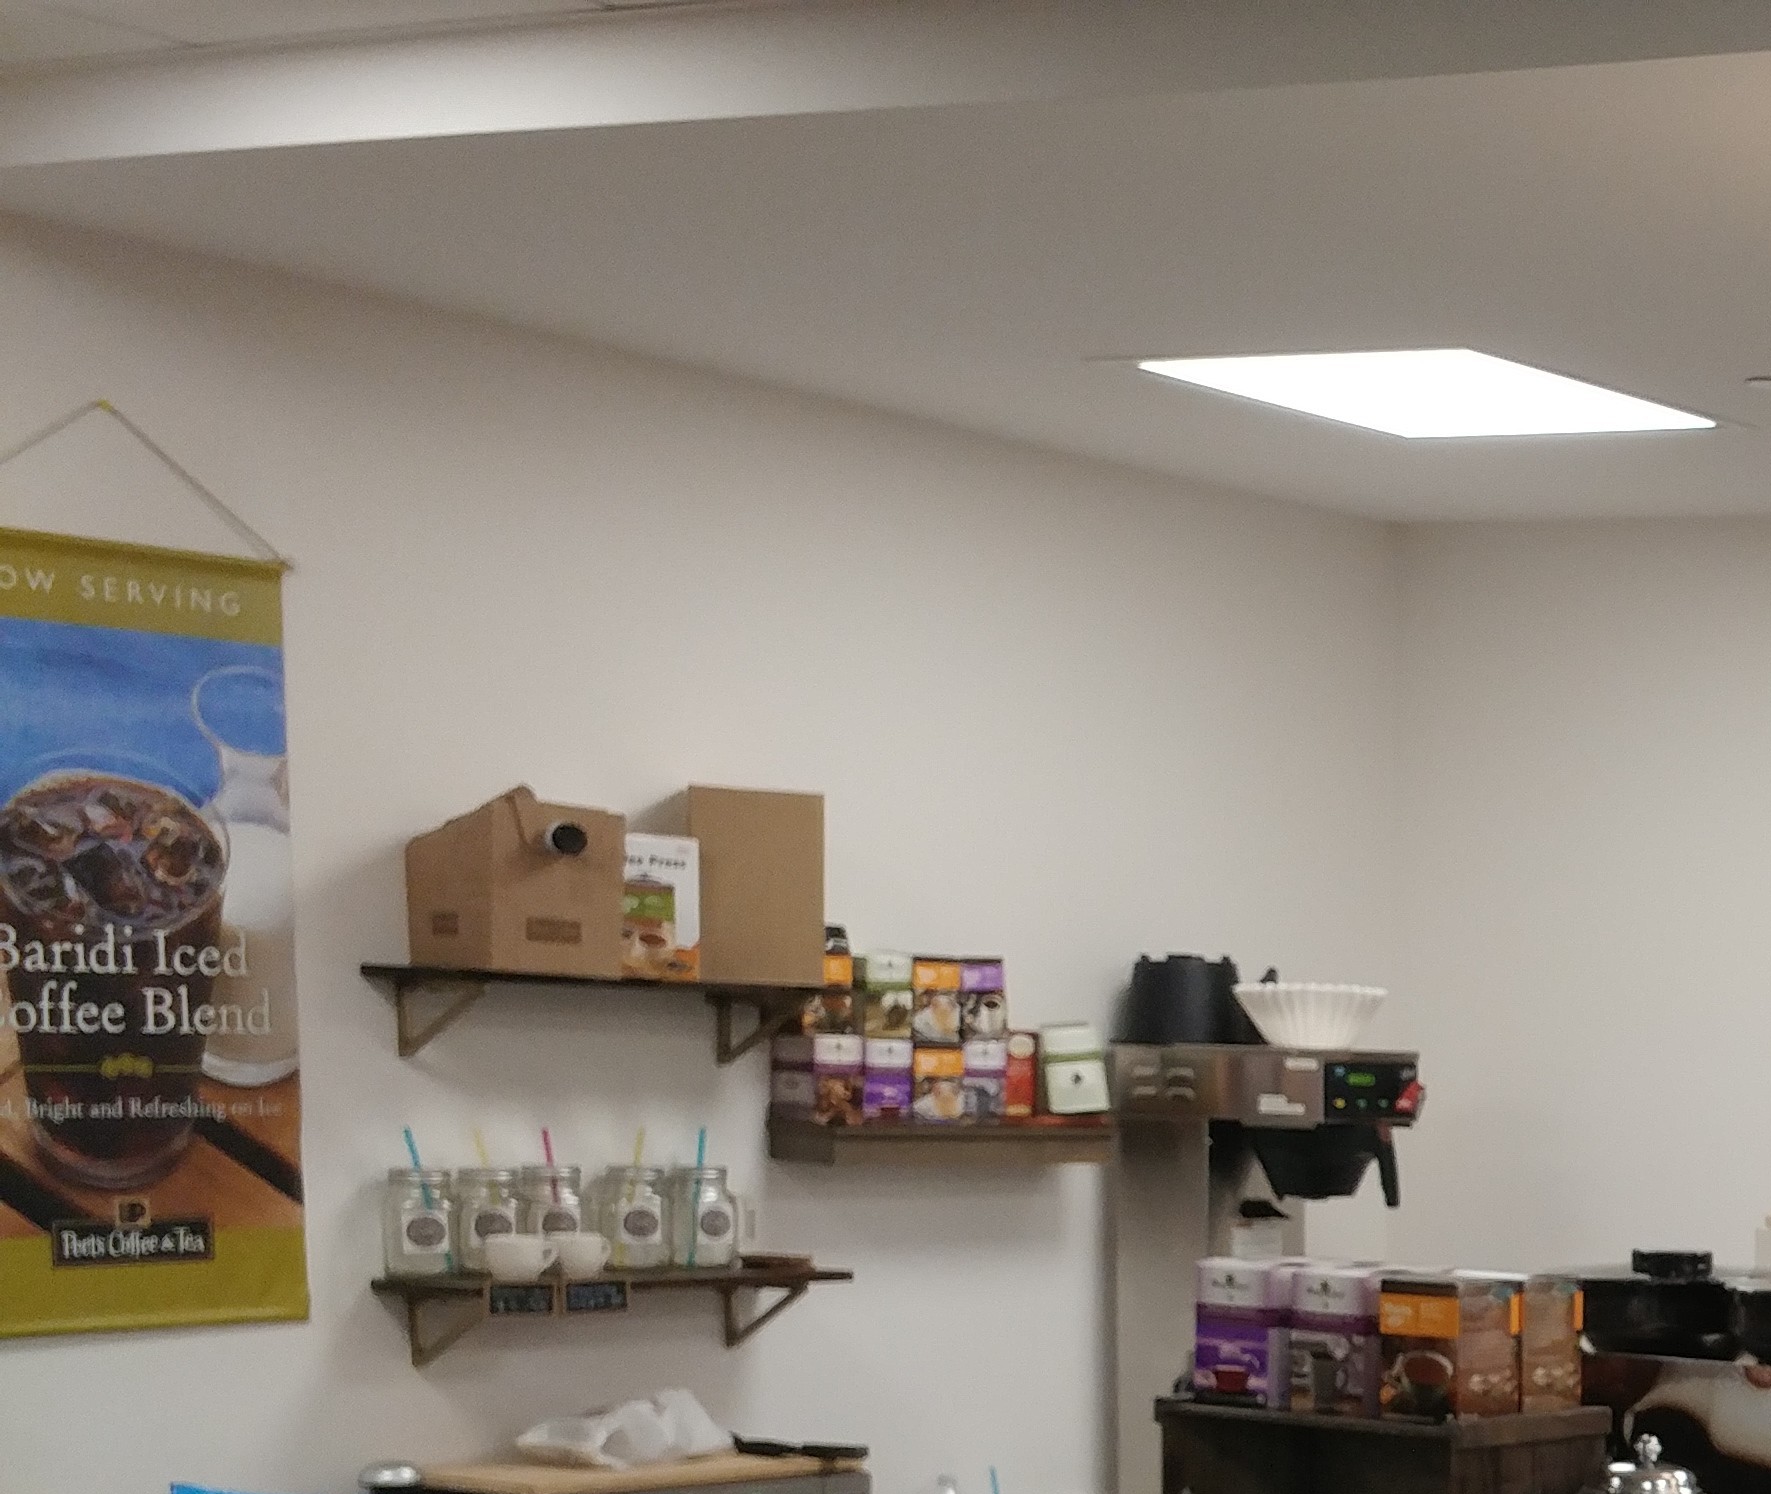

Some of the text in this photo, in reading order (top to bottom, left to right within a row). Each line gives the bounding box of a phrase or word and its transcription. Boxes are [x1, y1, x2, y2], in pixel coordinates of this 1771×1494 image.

[0, 564, 241, 616] OW SERVING
[0, 923, 248, 977] Baridi Iced
[0, 980, 272, 1035] offee Blend
[26, 1097, 84, 1124] Bright
[90, 1098, 123, 1119] and
[130, 1097, 226, 1123] Refreshing
